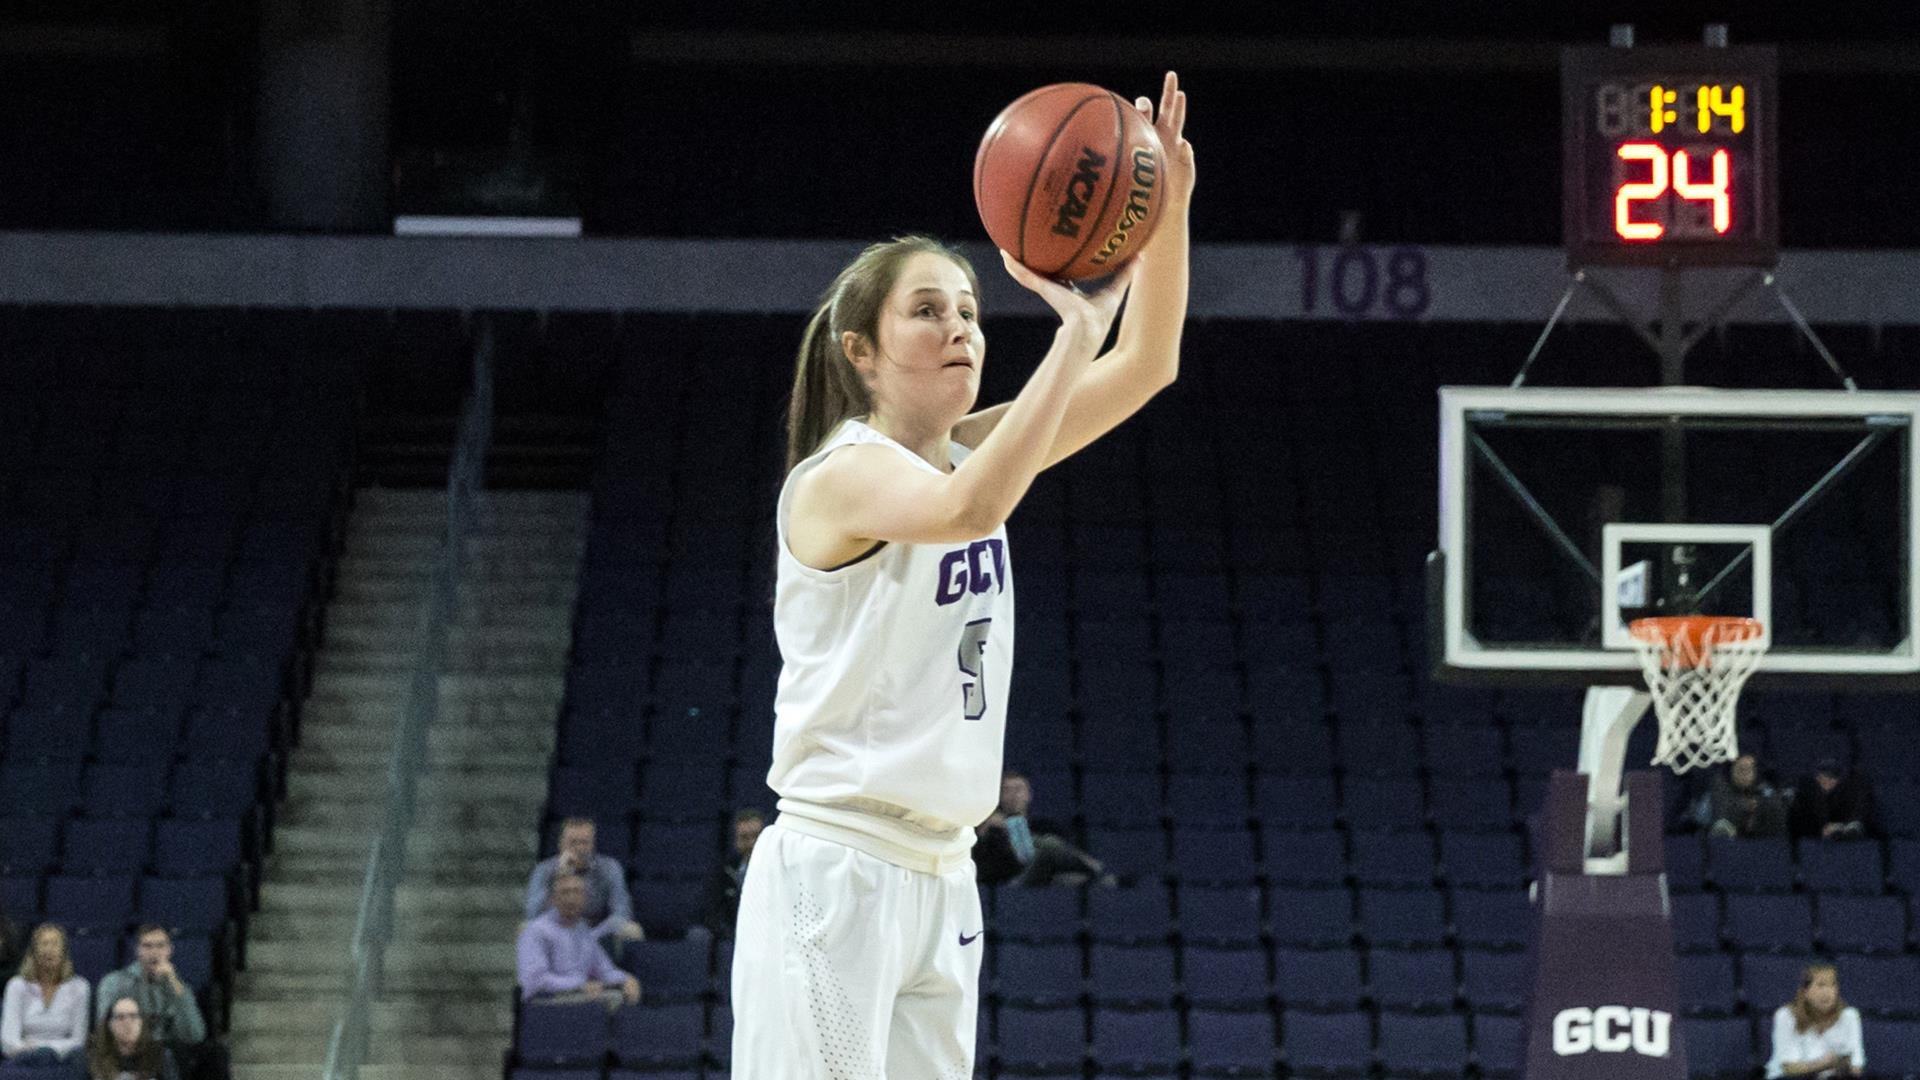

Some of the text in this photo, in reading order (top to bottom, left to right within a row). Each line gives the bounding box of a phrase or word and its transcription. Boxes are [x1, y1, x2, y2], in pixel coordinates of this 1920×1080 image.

[1650, 85, 1745, 134] 1:14
[1052, 146, 1107, 240] NCAA
[1089, 146, 1156, 266] Wilson
[1615, 142, 1731, 241] 24
[1296, 245, 1432, 322] 108
[1552, 1005, 1673, 1058] GCU
